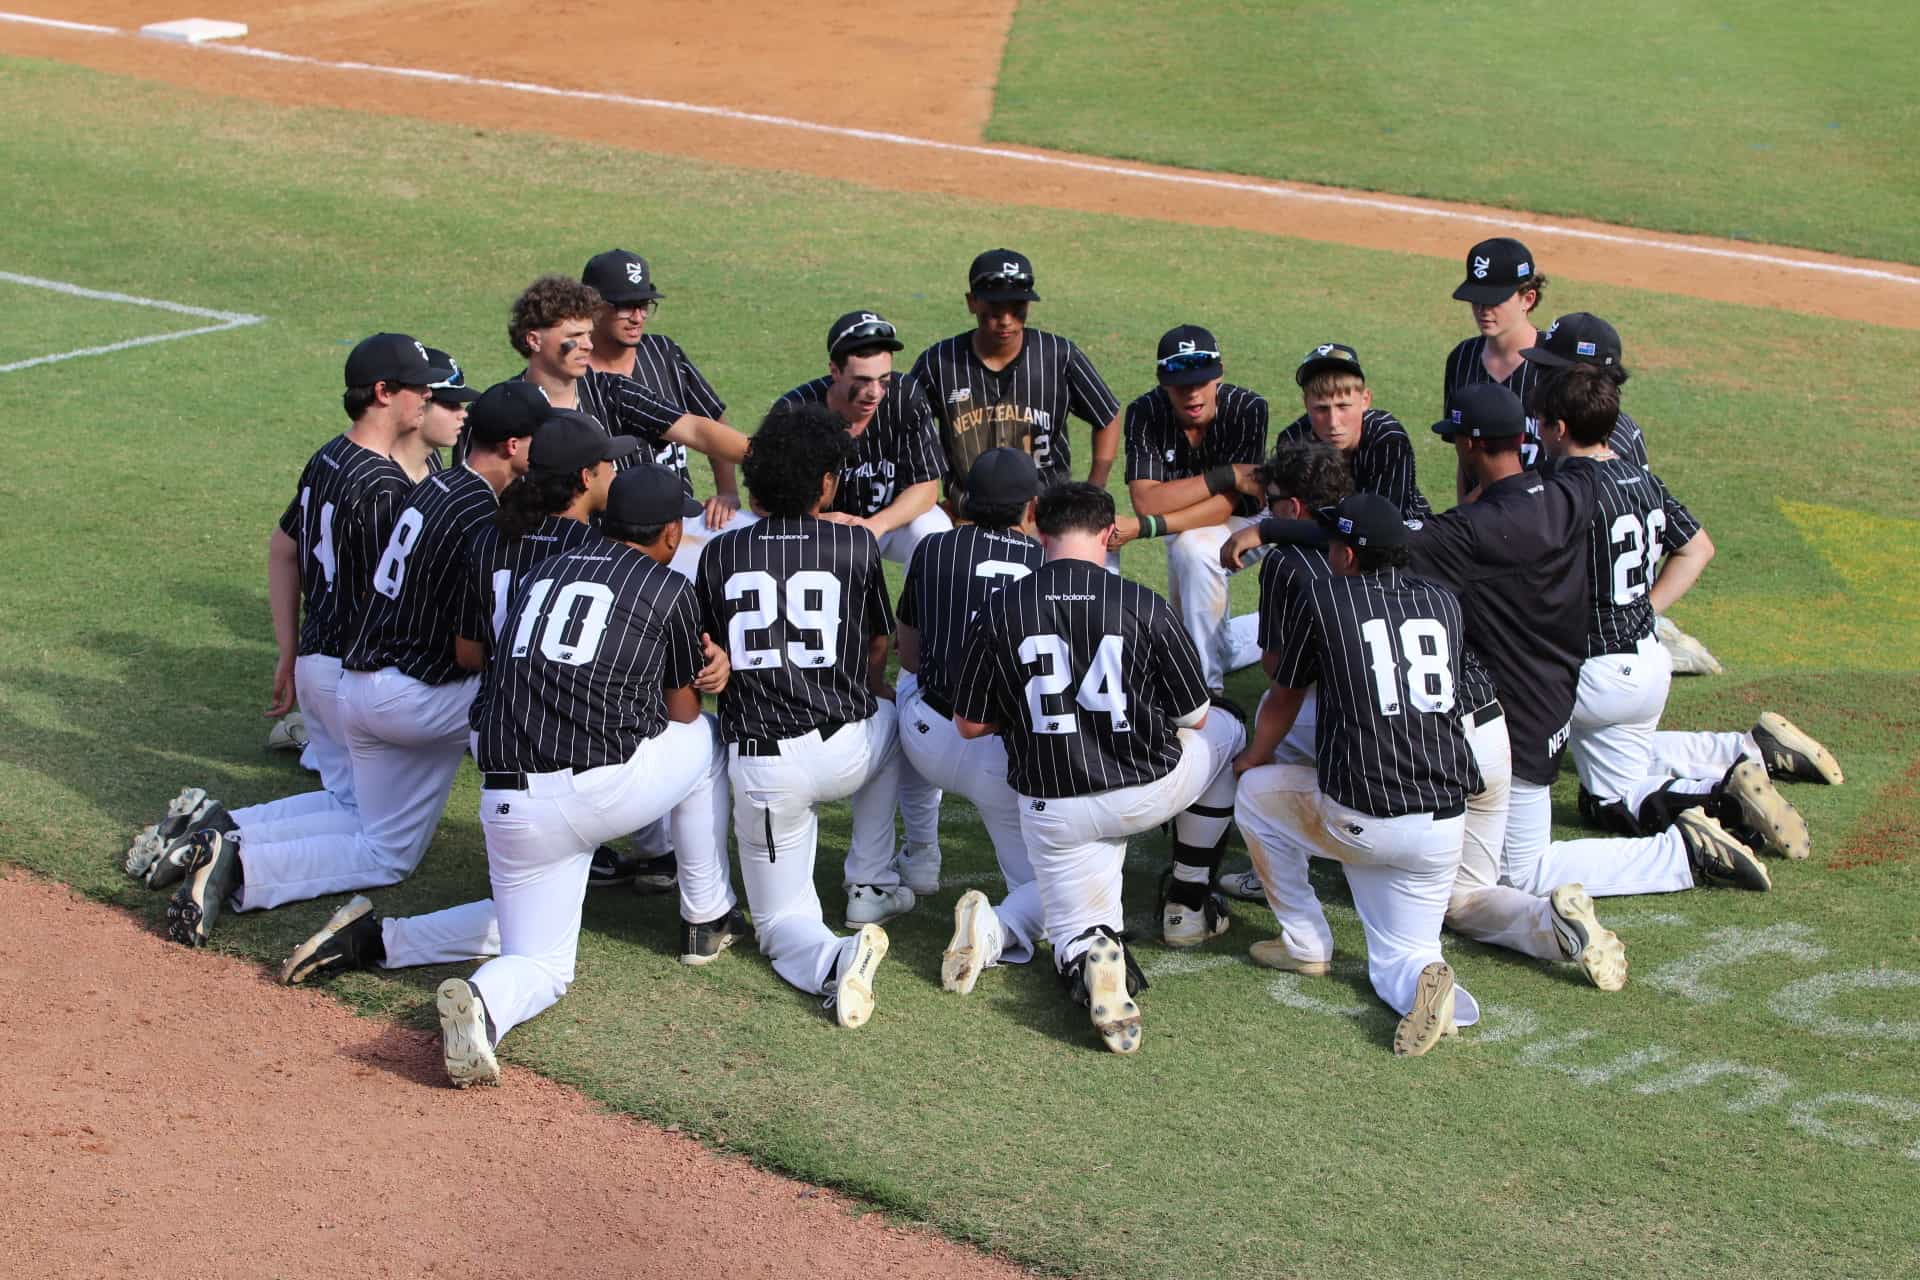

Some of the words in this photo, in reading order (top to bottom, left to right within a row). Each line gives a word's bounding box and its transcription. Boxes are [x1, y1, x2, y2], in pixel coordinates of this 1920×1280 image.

[953, 407, 983, 435] NEW
[986, 403, 1051, 431] ZEALAND
[373, 506, 424, 601] 8
[983, 532, 1000, 543] new
[1001, 535, 1035, 549] balance
[512, 578, 615, 667] 10
[724, 570, 842, 671] 29
[1045, 592, 1062, 602] new
[1062, 592, 1097, 602] balance
[1017, 633, 1132, 733] 24
[1361, 618, 1456, 717] 18
